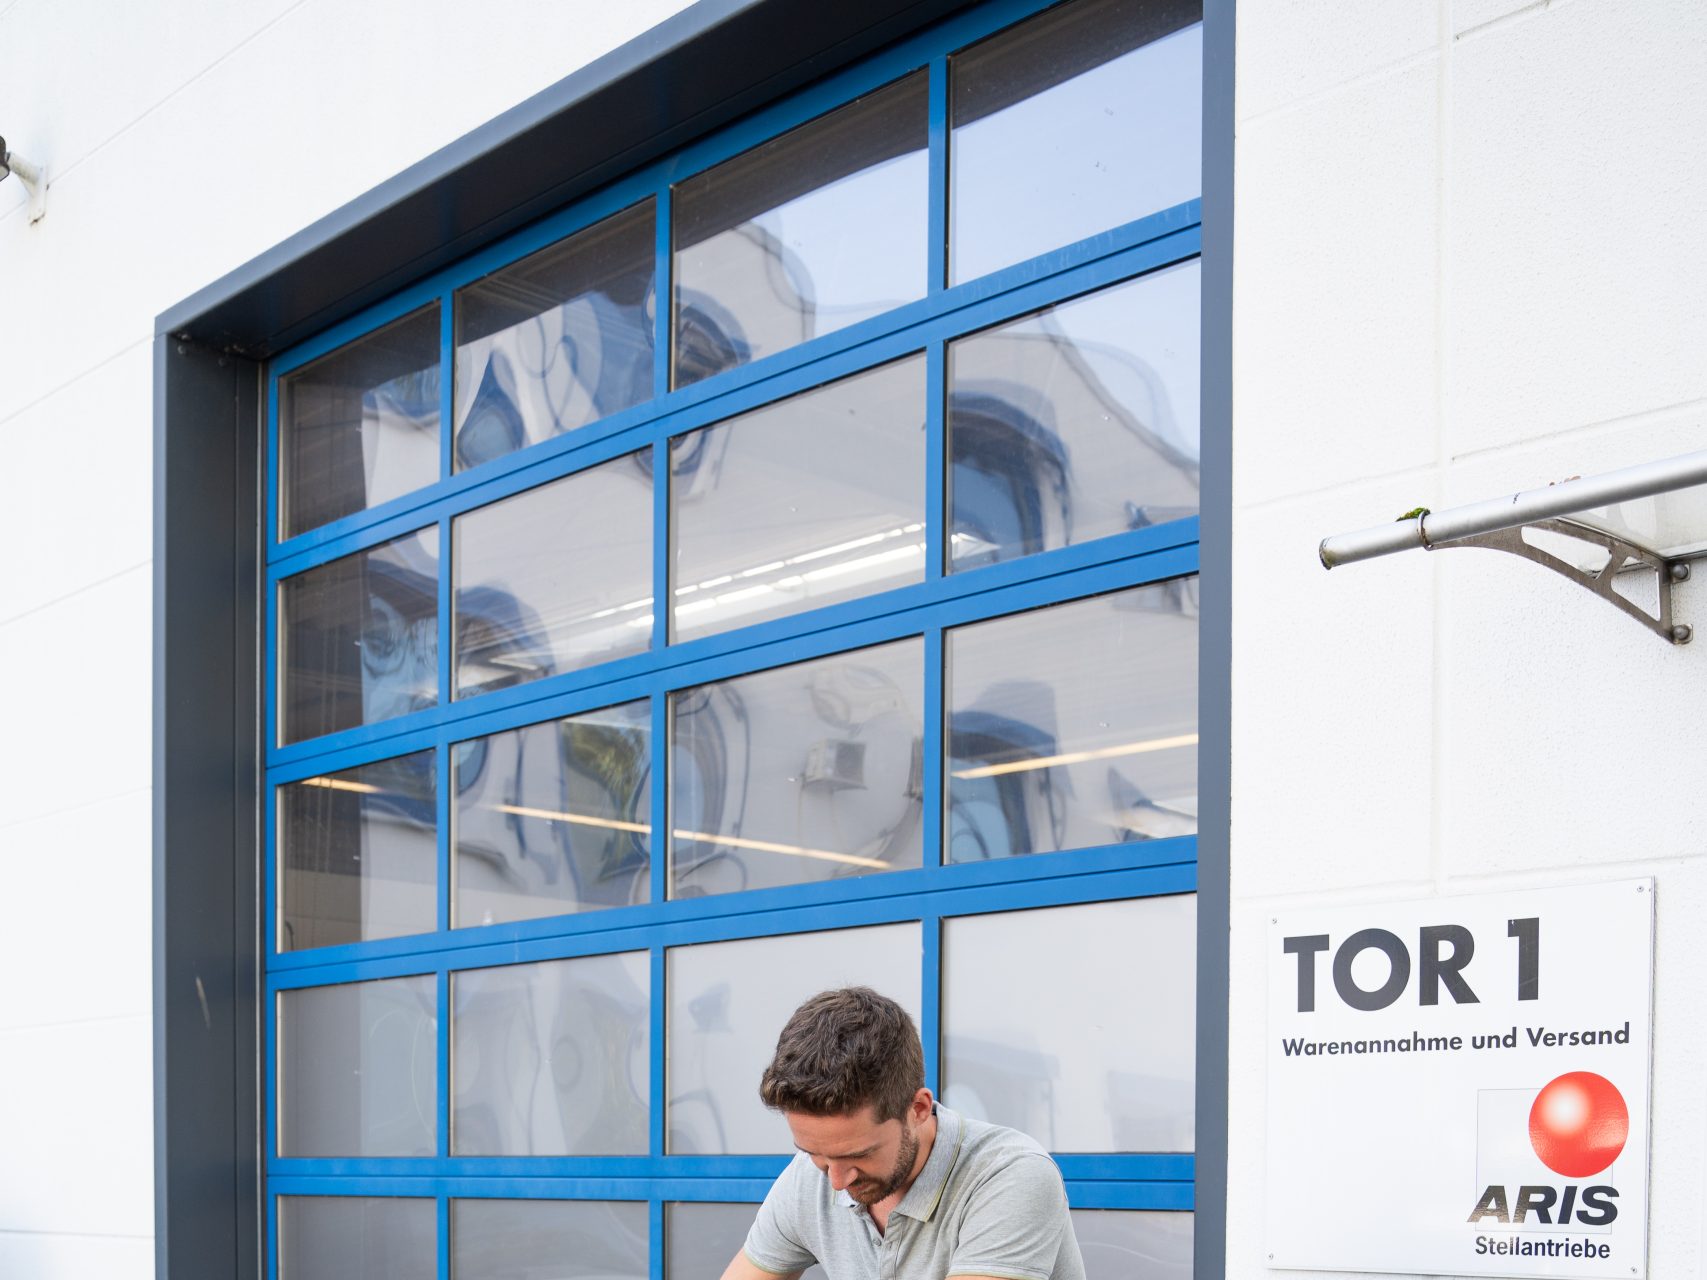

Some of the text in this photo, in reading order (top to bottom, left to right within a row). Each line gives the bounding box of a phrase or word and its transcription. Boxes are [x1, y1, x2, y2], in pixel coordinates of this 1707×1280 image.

[1283, 917, 1540, 1013] TOR 1
[1282, 1022, 1630, 1057] Warenannahme und Versand
[1466, 1184, 1620, 1226] ARIS
[1474, 1235, 1611, 1259] Stellantriebe
